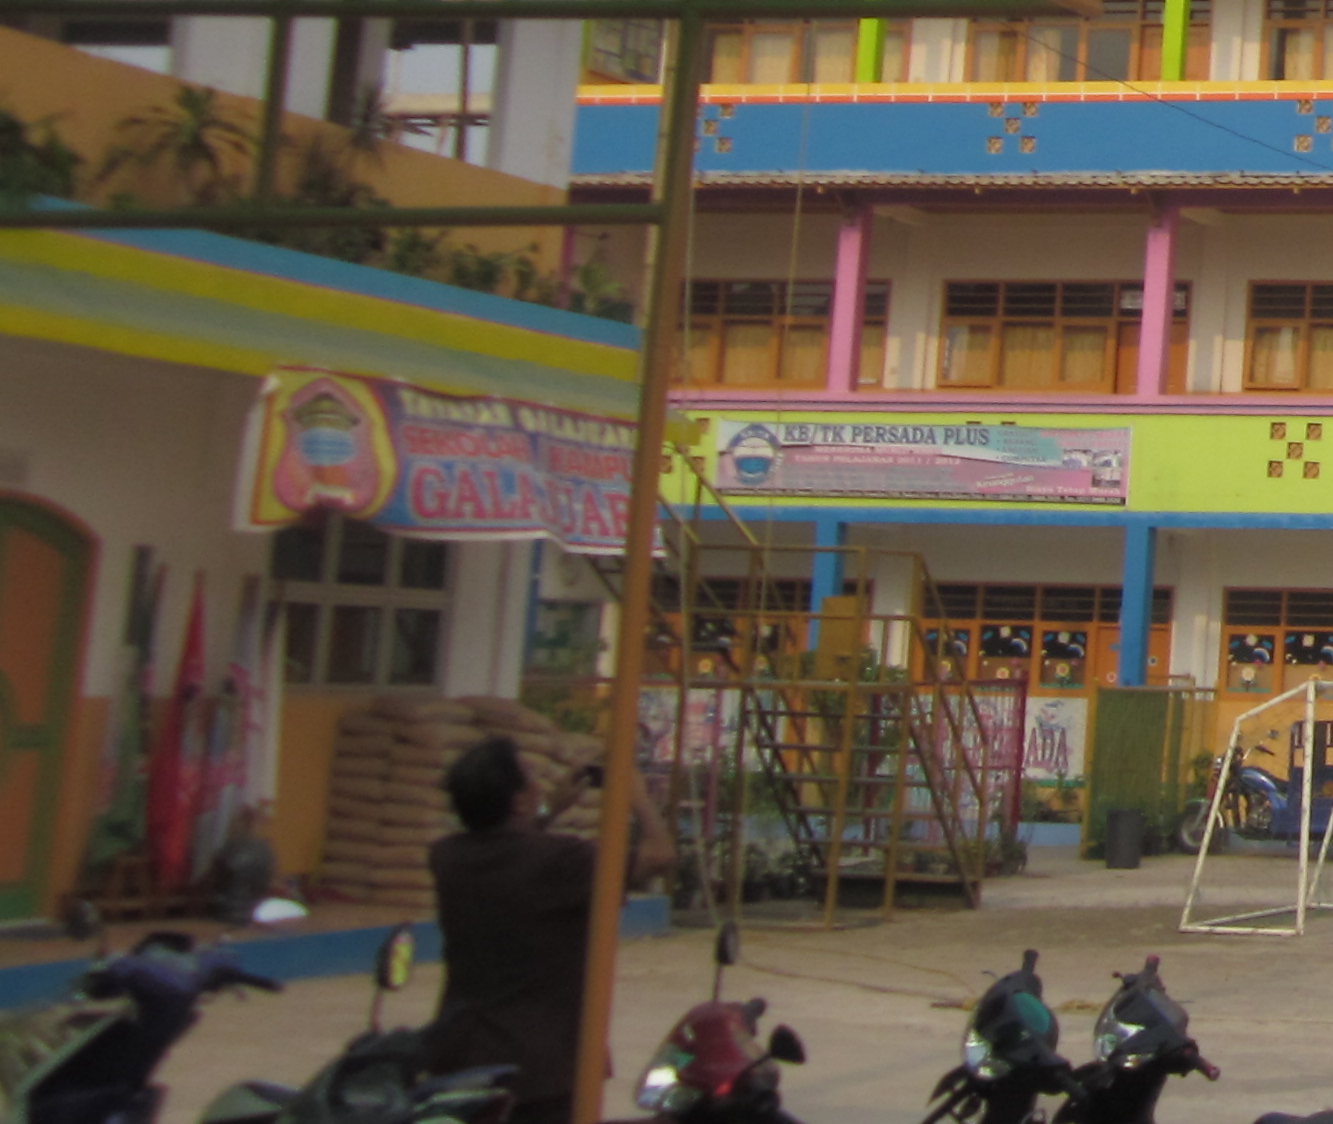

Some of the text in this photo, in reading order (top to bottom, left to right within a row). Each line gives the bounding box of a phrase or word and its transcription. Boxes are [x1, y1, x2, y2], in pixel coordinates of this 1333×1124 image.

[783, 425, 845, 443] KB/TK
[851, 426, 936, 444] PERSADA
[943, 427, 990, 446] PLUS
[409, 464, 634, 540] GALAJUAR
